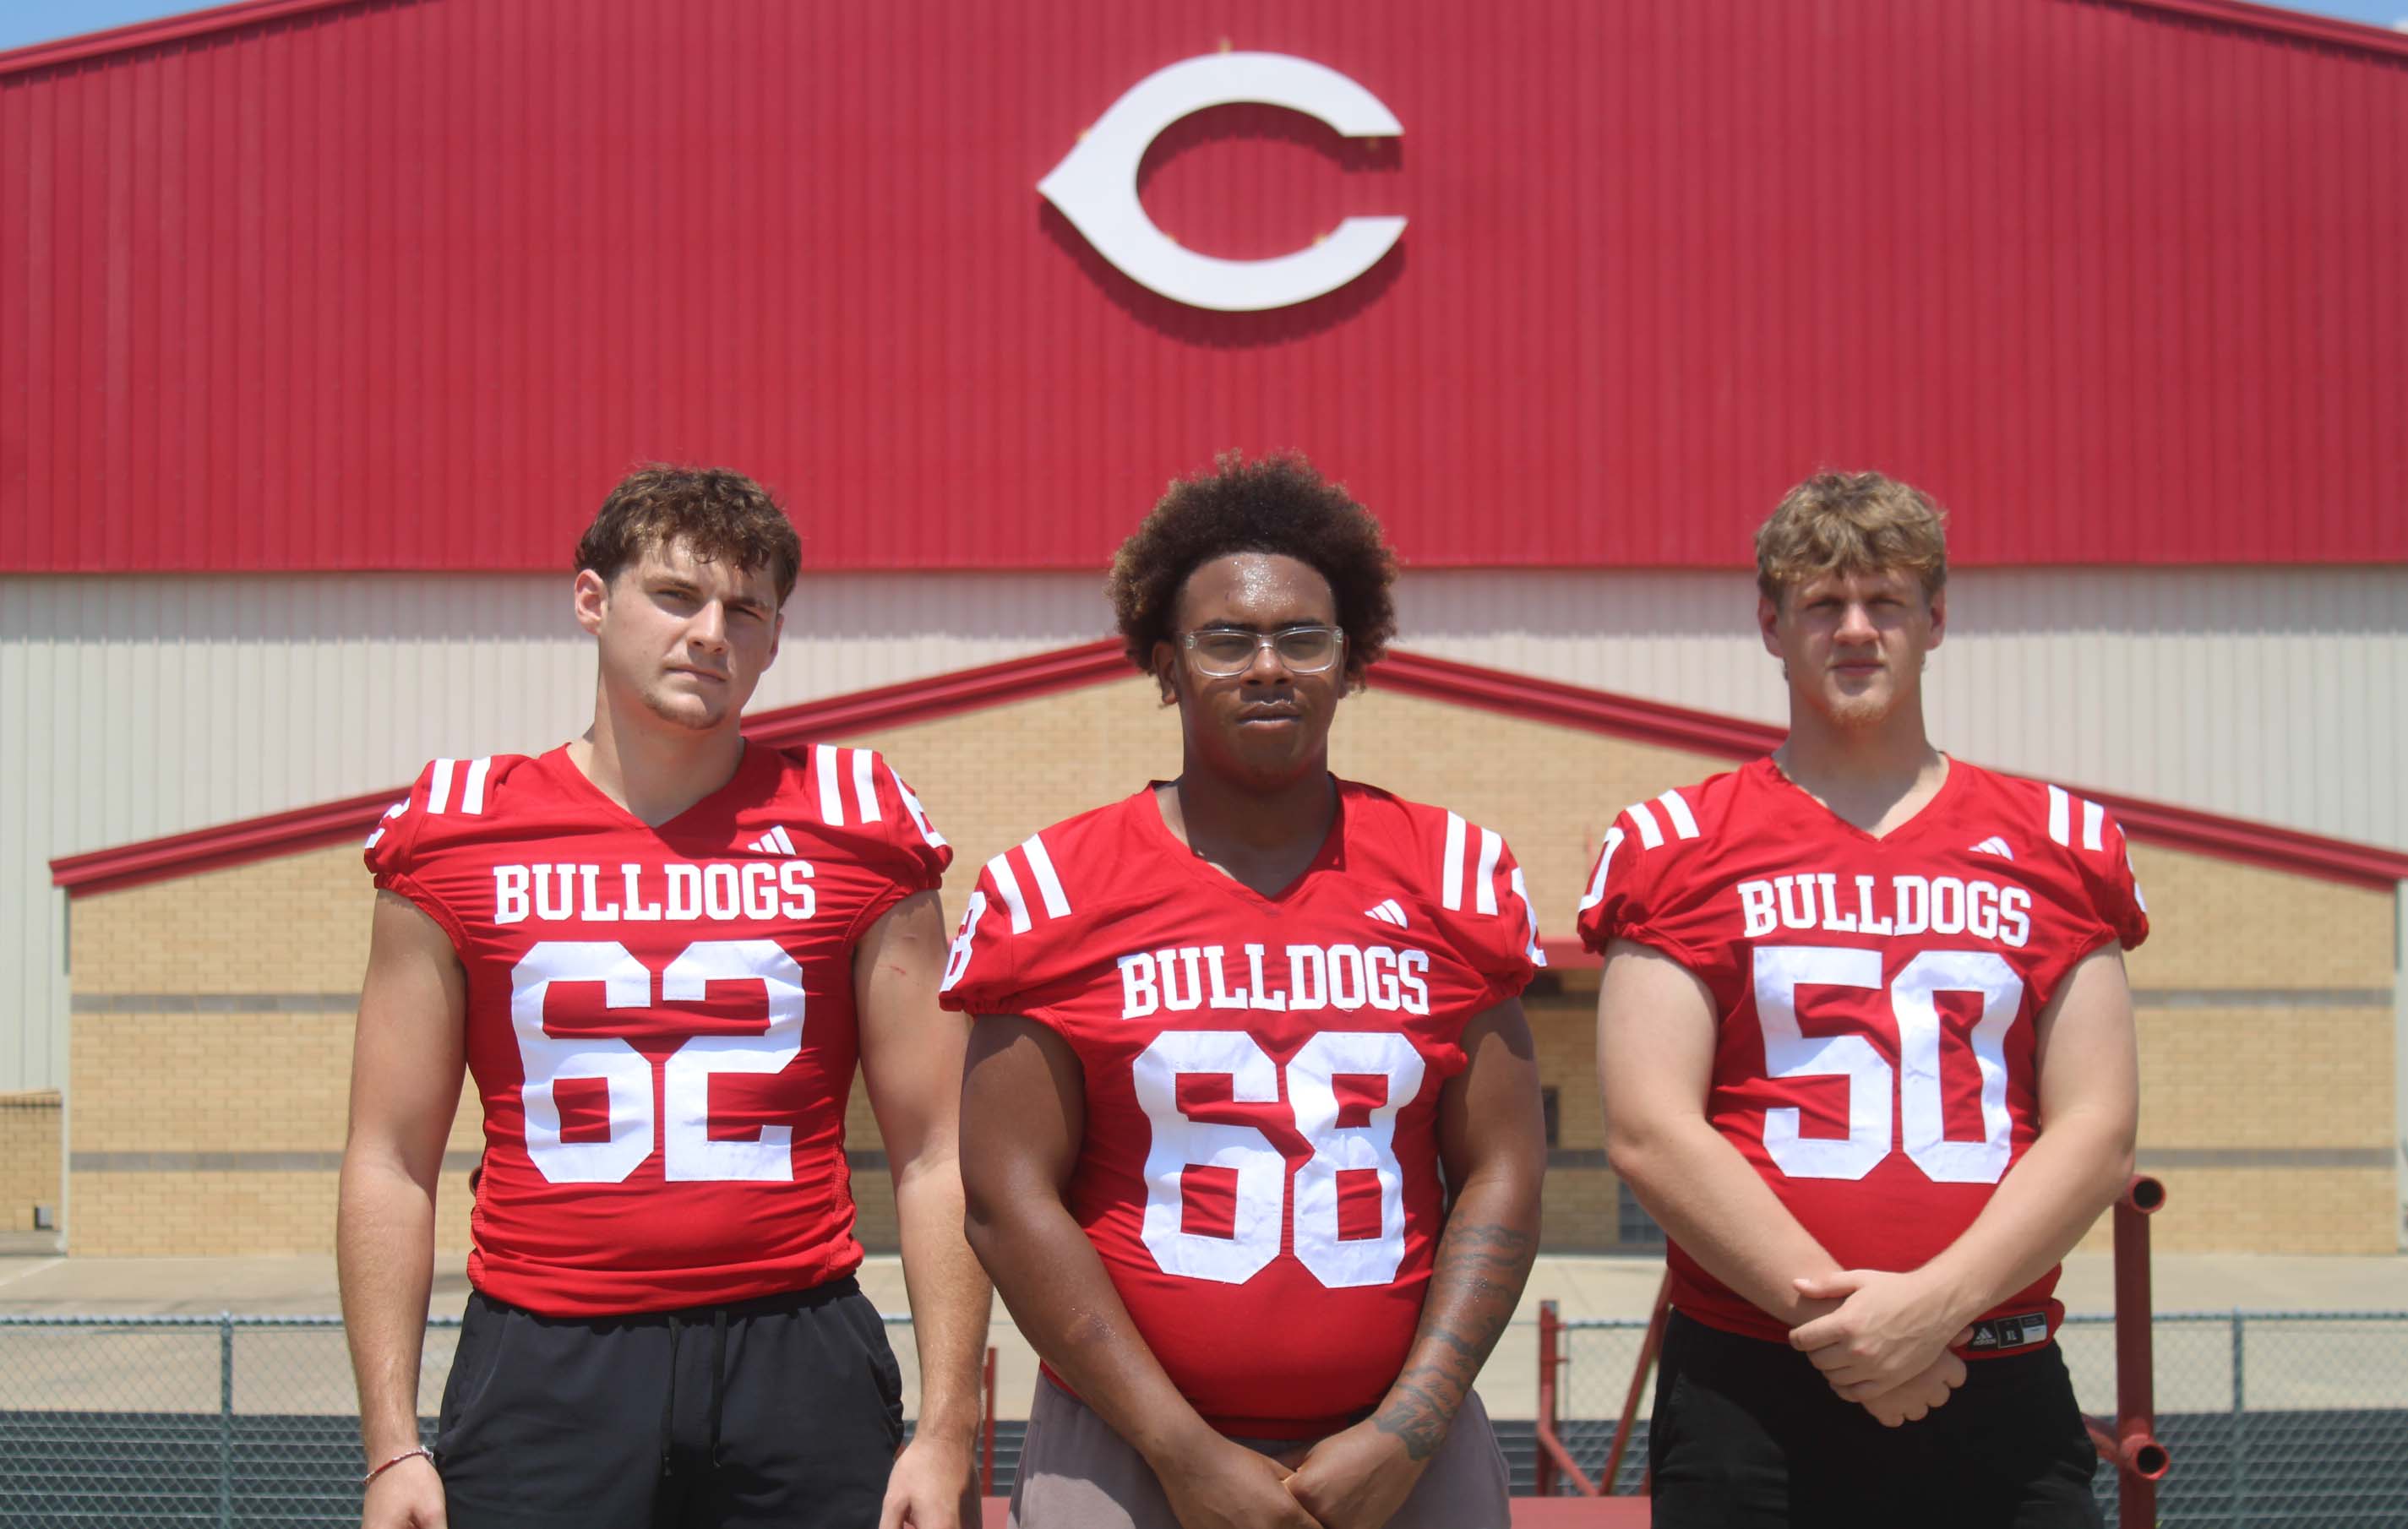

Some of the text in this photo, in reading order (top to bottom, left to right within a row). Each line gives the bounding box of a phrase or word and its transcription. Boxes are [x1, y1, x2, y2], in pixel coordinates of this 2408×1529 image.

[1038, 50, 1407, 310] C
[493, 861, 816, 925] BULLDOGS
[1117, 943, 1430, 1020] BULLDOGS
[1736, 873, 2032, 948] BULLDOGS
[510, 939, 806, 1184] 62
[1133, 1031, 1426, 1288] 68
[1753, 946, 2024, 1184] 50
